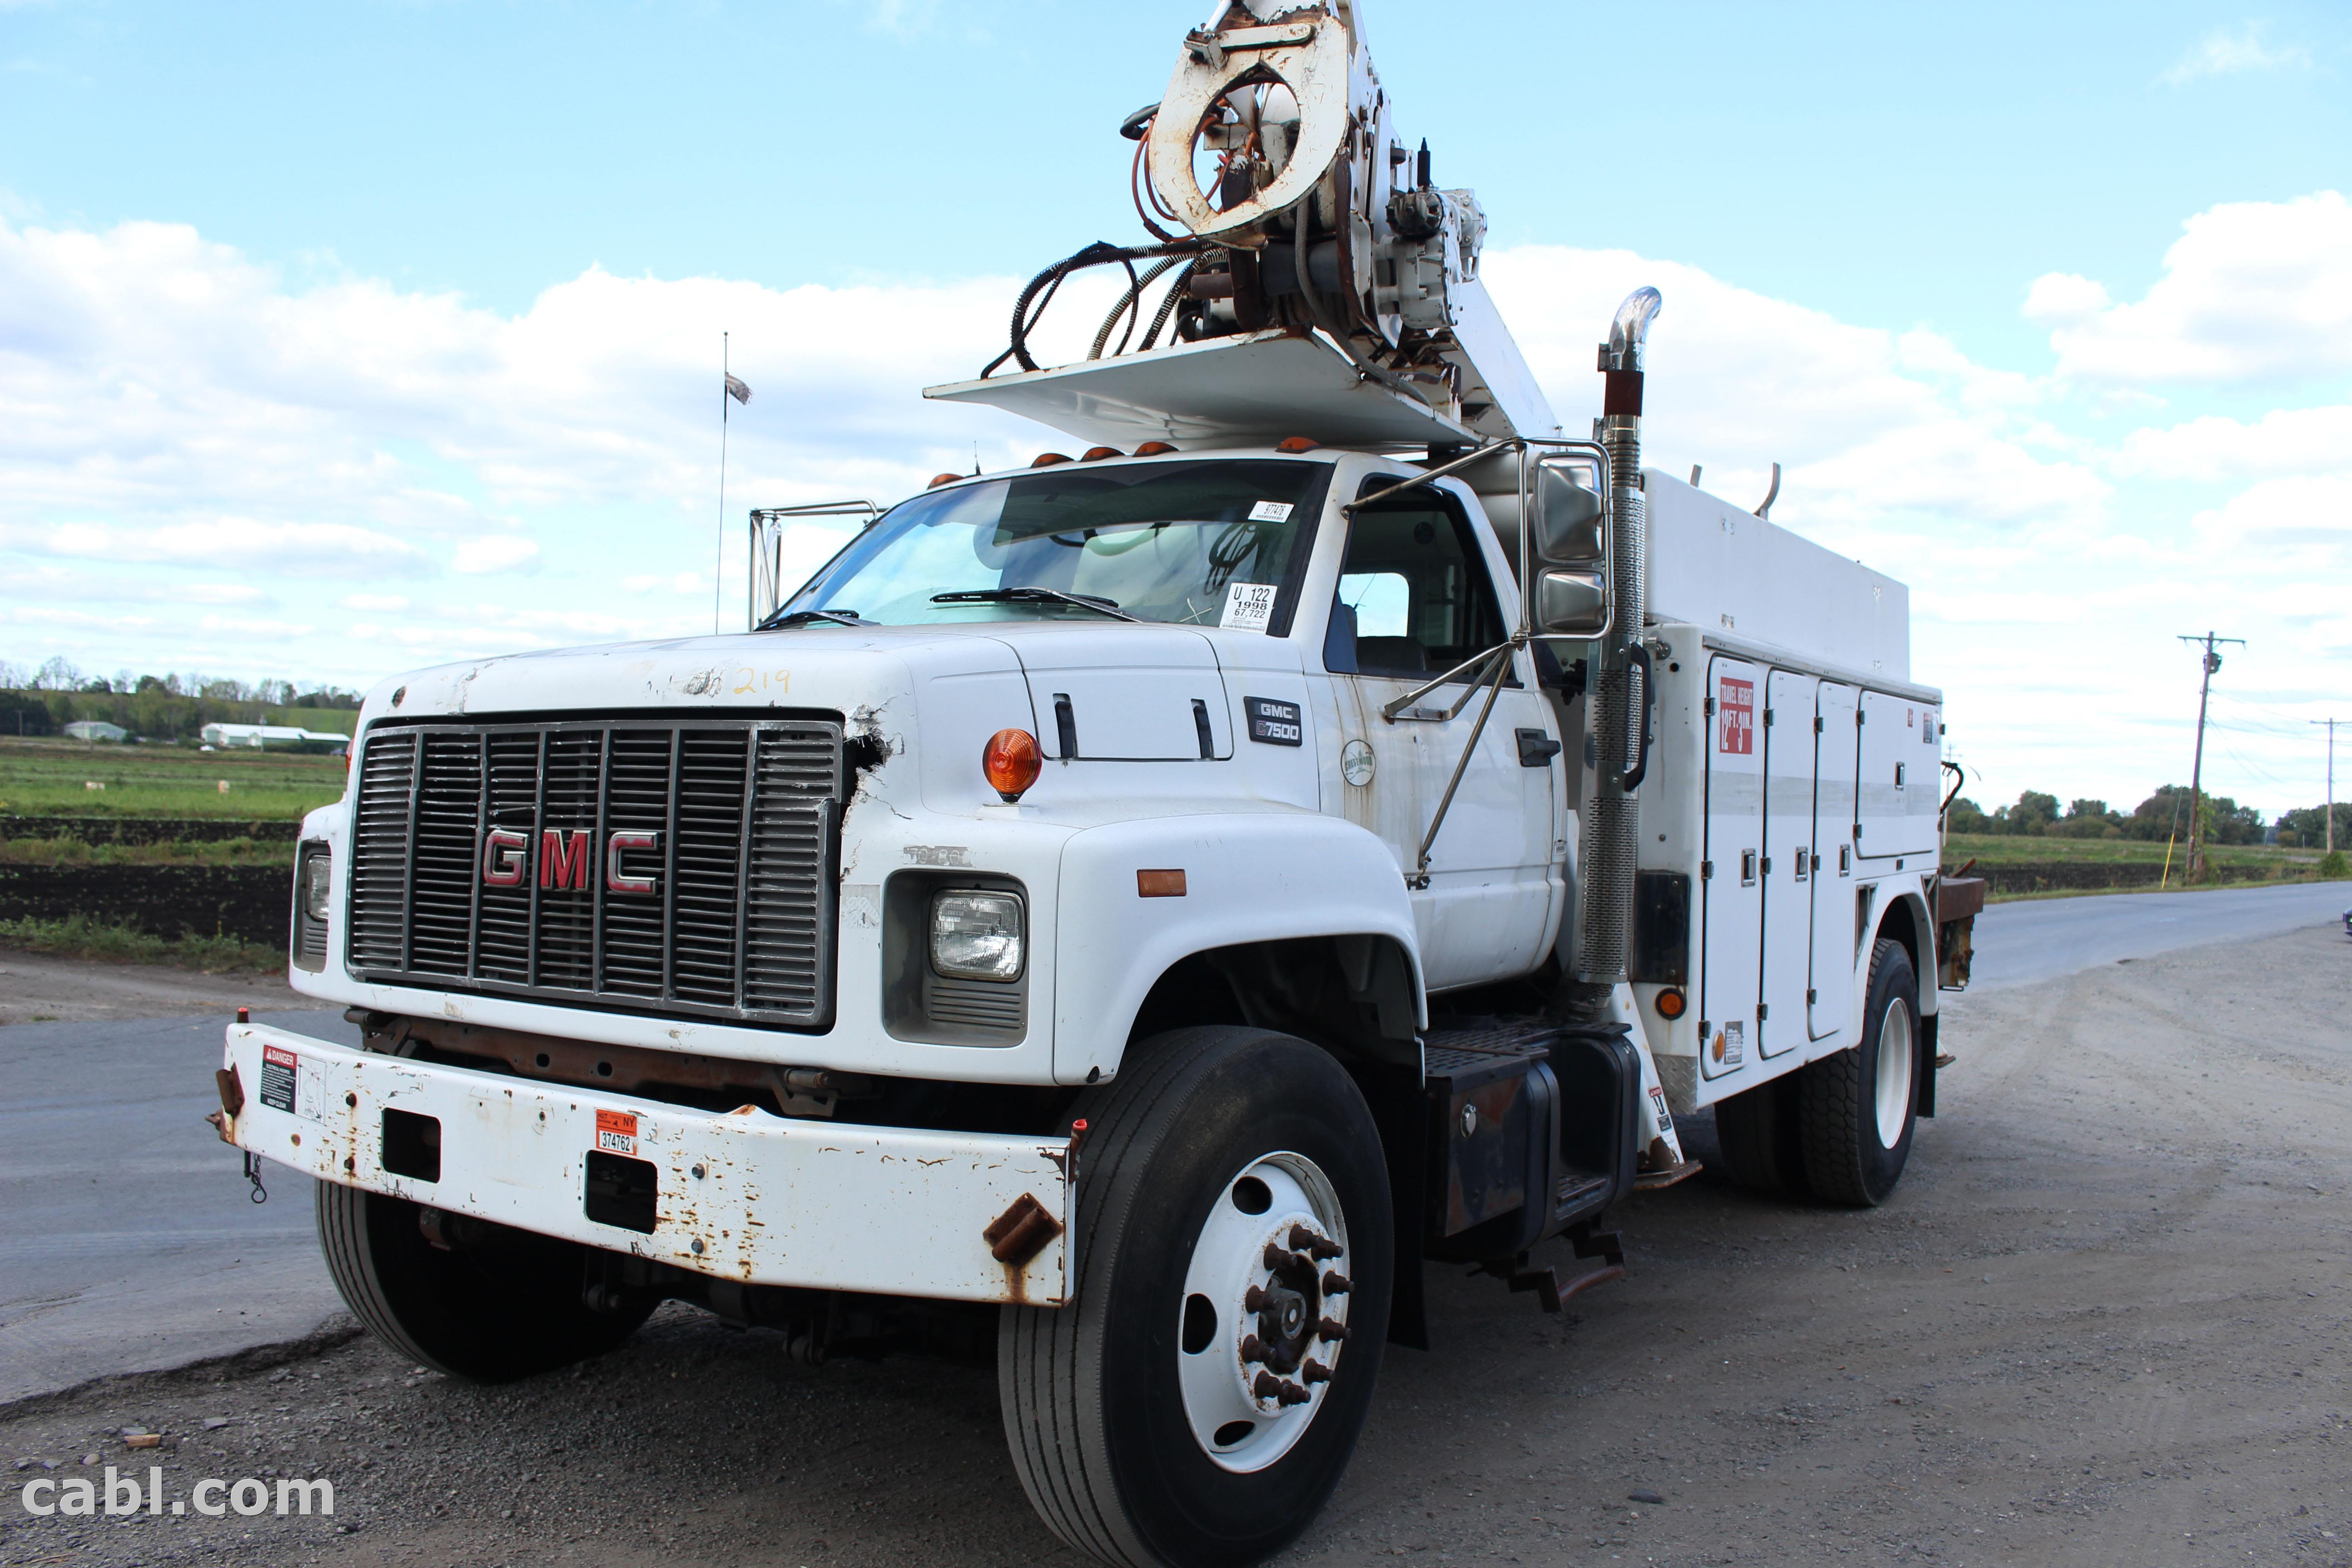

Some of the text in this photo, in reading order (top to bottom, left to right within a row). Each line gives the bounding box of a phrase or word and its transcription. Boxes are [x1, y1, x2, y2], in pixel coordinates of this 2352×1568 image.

[1264, 504, 1286, 516] 977476
[1234, 586, 1270, 602] U 122
[1235, 608, 1265, 618] 67,722
[1237, 601, 1267, 610] 1998
[734, 668, 791, 694] 219
[1721, 684, 1753, 706] TRAVEL HEIGHT
[1261, 703, 1292, 719] GMC
[1256, 720, 1299, 740] C7500
[1345, 756, 1373, 771] CRESTWOOD
[483, 829, 658, 896] GMC
[272, 1050, 294, 1066] DANGER
[623, 1117, 635, 1127] NY
[603, 1132, 630, 1152] 374762
